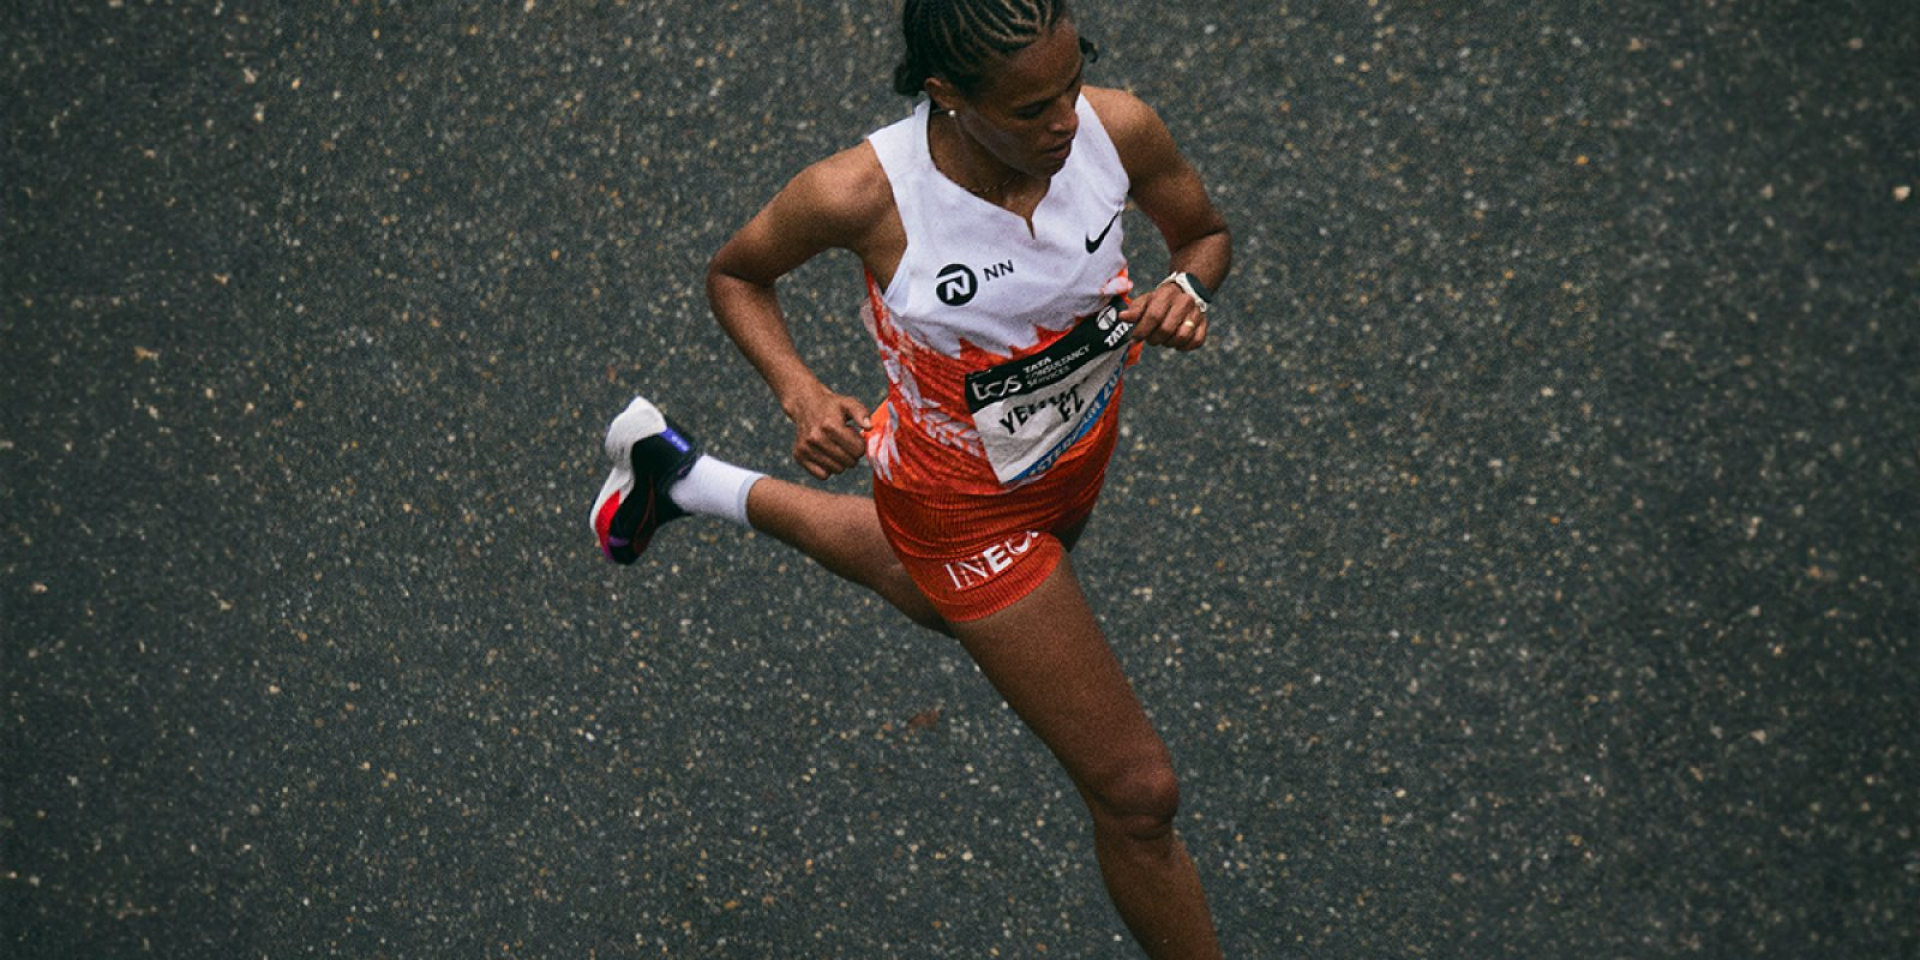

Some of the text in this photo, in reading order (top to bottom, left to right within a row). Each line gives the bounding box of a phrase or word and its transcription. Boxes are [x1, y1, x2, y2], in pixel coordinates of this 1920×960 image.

[983, 259, 1015, 282] NN
[1104, 321, 1133, 347] TATA
[1023, 356, 1052, 374] TATA
[1025, 344, 1090, 380] CONSULTANCY
[943, 530, 1039, 590] INEO
